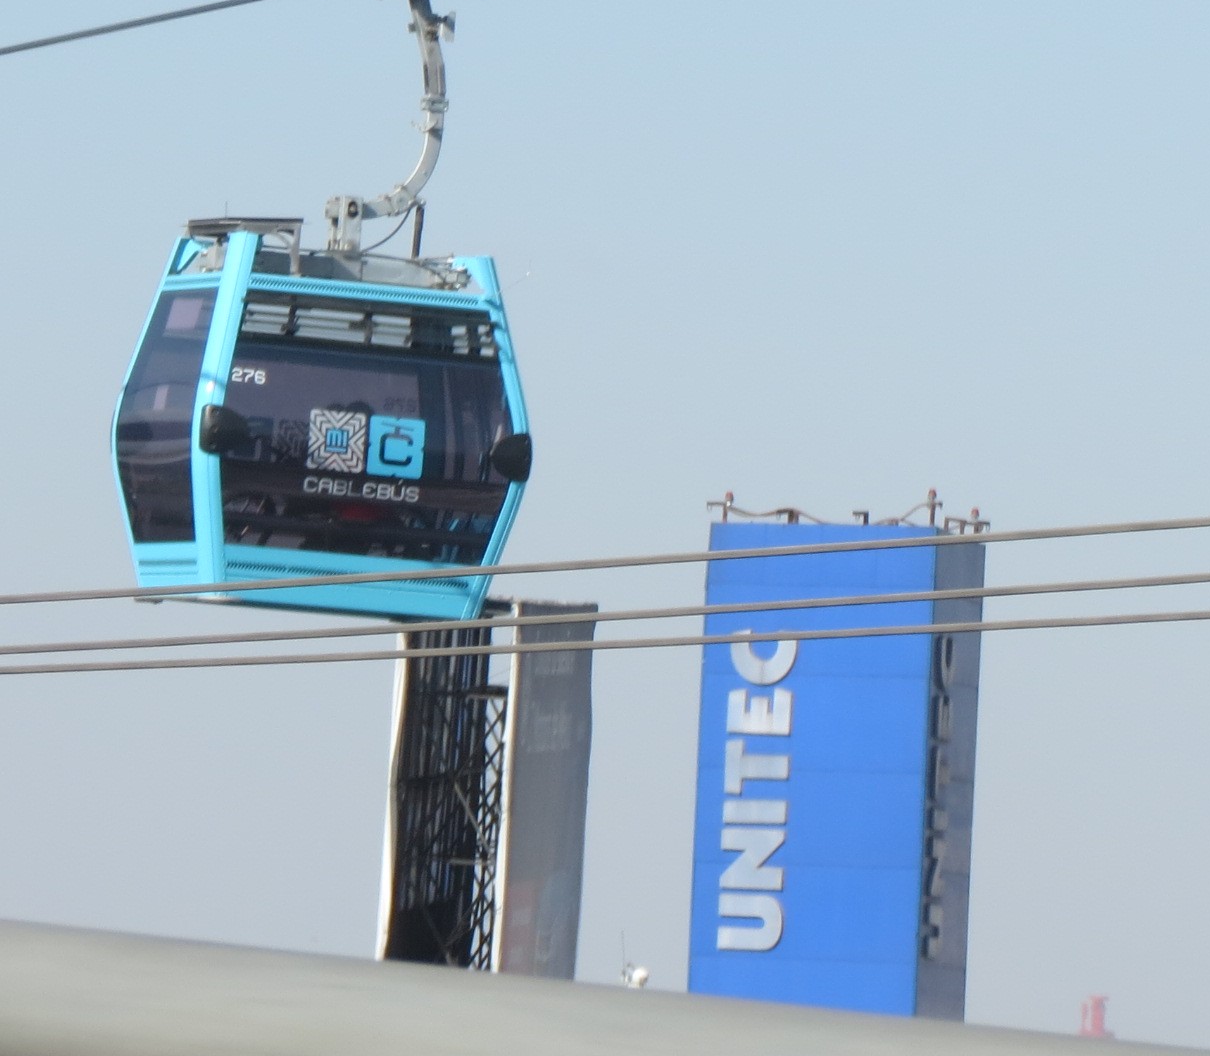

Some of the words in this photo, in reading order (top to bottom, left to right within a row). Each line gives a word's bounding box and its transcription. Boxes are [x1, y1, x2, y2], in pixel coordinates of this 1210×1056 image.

[231, 366, 266, 385] 276
[303, 476, 420, 503] CABLEBÚS
[716, 629, 799, 953] UNITEC
